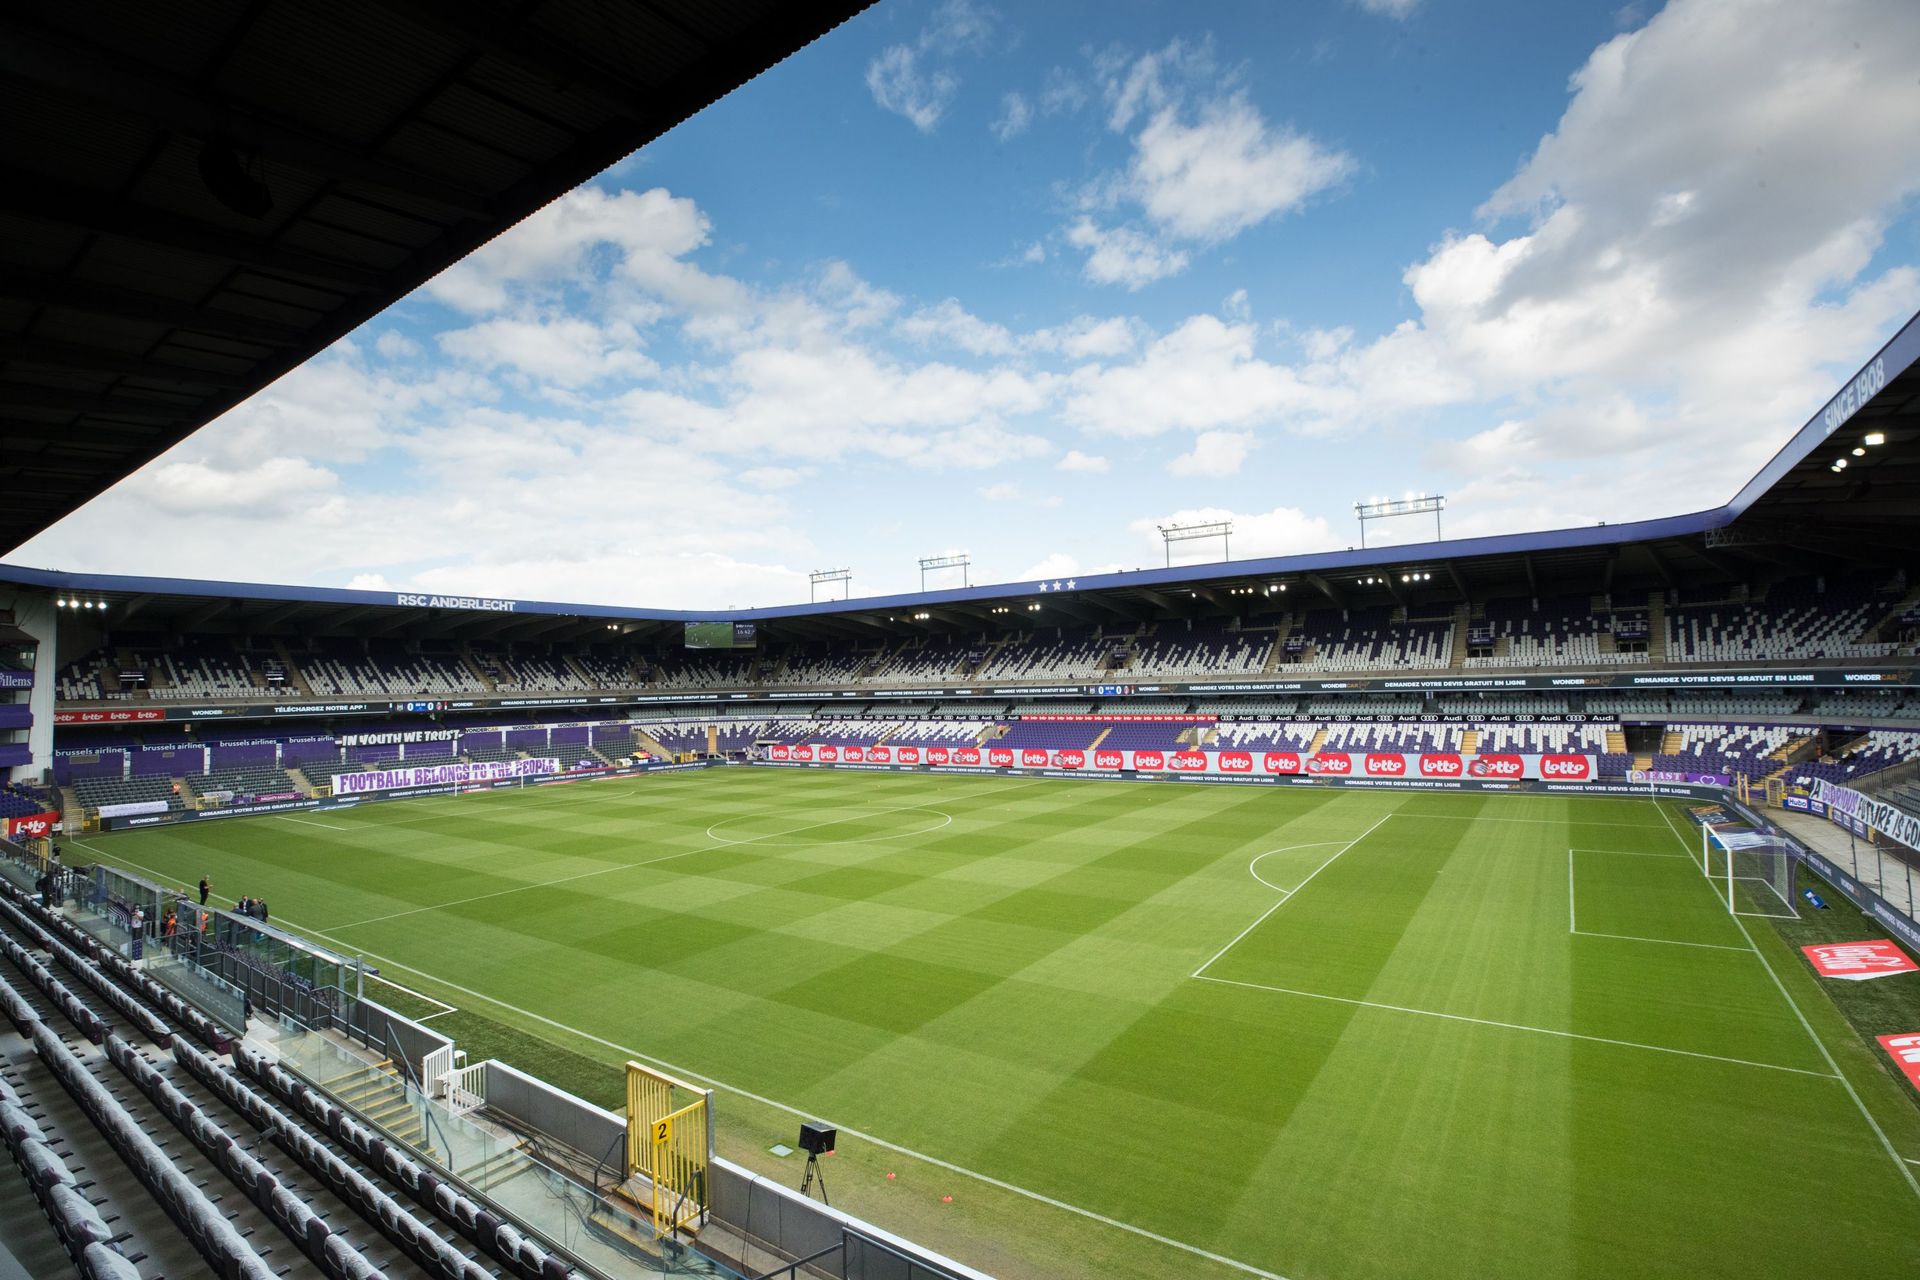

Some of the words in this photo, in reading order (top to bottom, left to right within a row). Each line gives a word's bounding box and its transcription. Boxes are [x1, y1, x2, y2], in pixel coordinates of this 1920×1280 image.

[1825, 387, 1855, 434] SINCE
[1855, 358, 1885, 406] 1908
[397, 594, 427, 606] RSC
[430, 596, 516, 611] ANDERLECHT
[1098, 686, 1104, 695] 0
[1116, 686, 1122, 695] 0
[407, 702, 414, 711] 0
[427, 702, 434, 711] 0
[360, 732, 402, 745] YOUTH
[404, 731, 422, 743] WE
[424, 730, 460, 741] TRUST
[55, 748, 93, 757] brussels
[900, 752, 916, 760] lotto
[928, 753, 947, 761] lotto
[991, 753, 1011, 762] lotto
[1024, 753, 1046, 763] lotto
[1097, 754, 1120, 764] lotto
[1136, 755, 1161, 766] lotto
[1221, 756, 1250, 768] lotto
[1267, 757, 1297, 770] lotto
[1368, 758, 1402, 771] lotto
[1423, 759, 1459, 772] lotto
[1544, 760, 1585, 774] lotto
[340, 771, 410, 793] FOOTBALL
[414, 764, 470, 785] BELONGS
[472, 763, 487, 778] TO
[489, 762, 512, 778] THE
[516, 758, 555, 777] PEOPLE
[1650, 772, 1681, 780] EAST
[1788, 798, 1807, 807] Hubo
[1811, 780, 1821, 798] A
[1822, 782, 1860, 814] GLORIOUS
[1857, 797, 1894, 832] FUTURE
[1892, 814, 1904, 838] IS
[658, 1123, 667, 1140] 2
